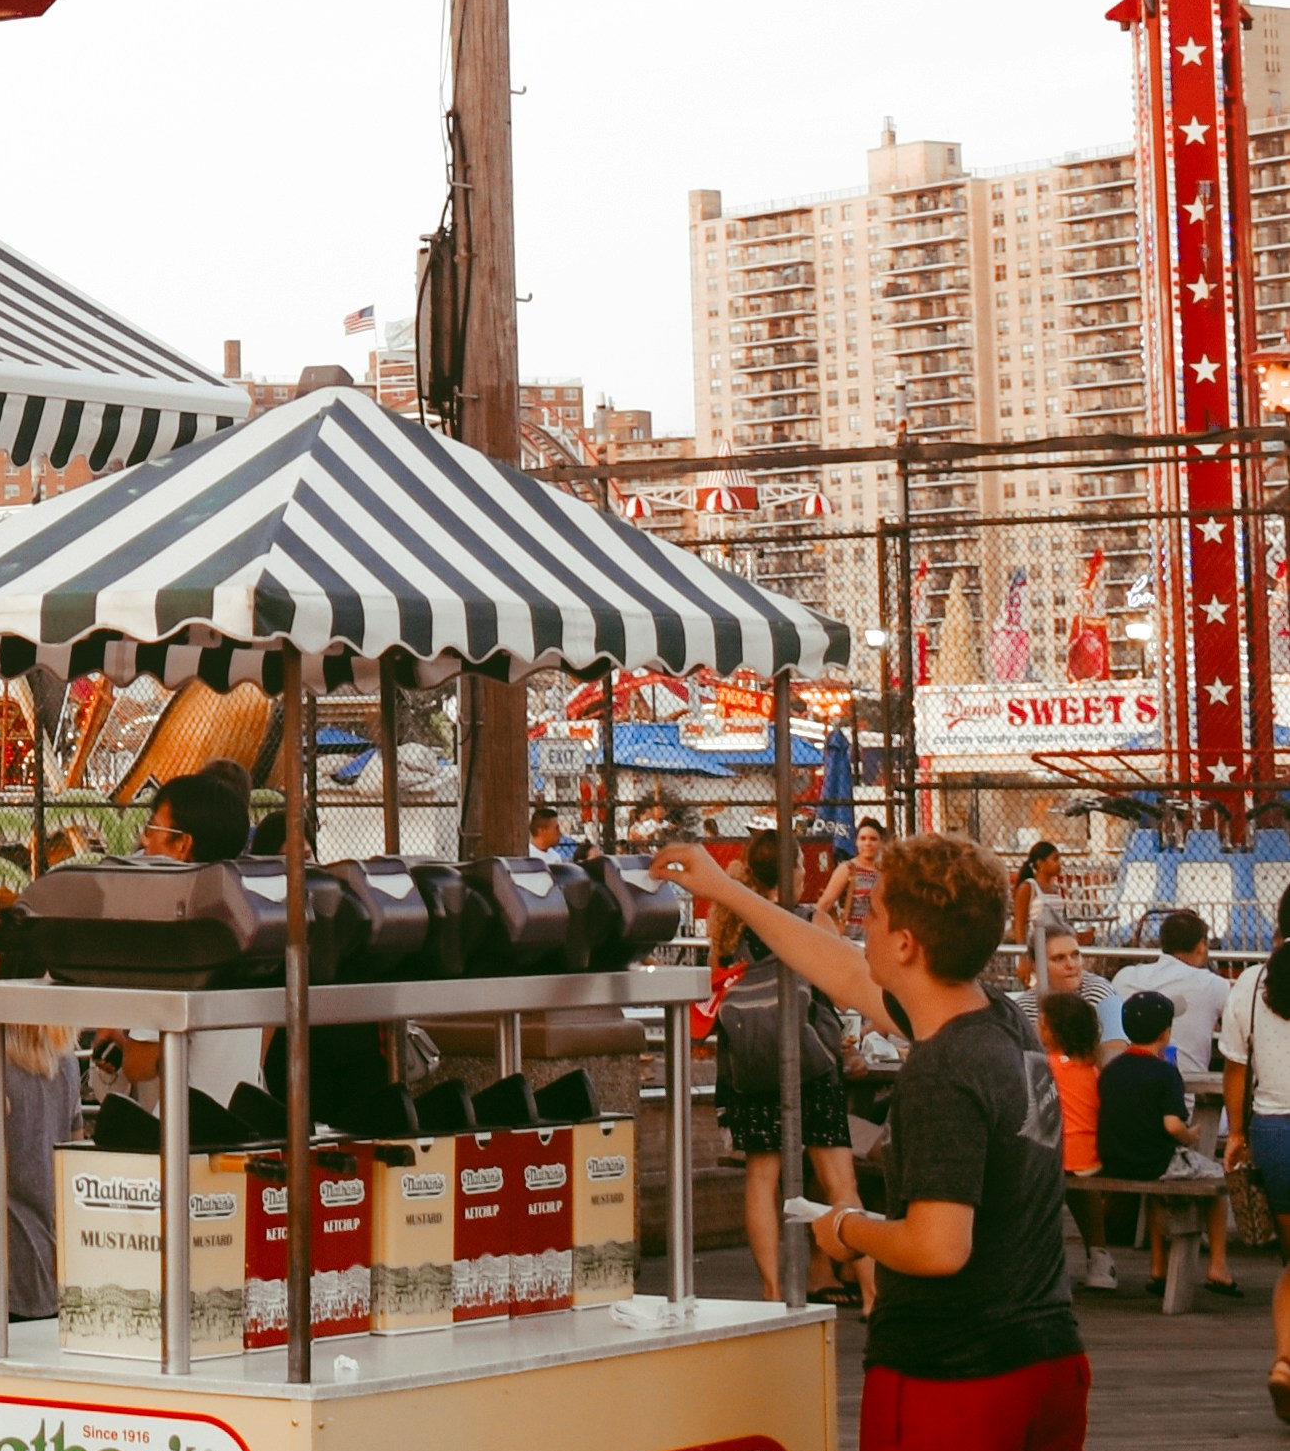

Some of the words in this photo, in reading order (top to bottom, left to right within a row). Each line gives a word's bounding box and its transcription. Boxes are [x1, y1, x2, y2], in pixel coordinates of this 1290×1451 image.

[976, 735, 1011, 745] candy
[548, 749, 575, 764] EXIT
[76, 1176, 162, 1202] Nathan's
[190, 1195, 236, 1213] Nathan's
[590, 1192, 625, 1206] MUSTARD
[464, 1203, 500, 1219] KETCHUP
[528, 1200, 563, 1216] KETCHUP
[323, 1217, 361, 1233] KETCHUP
[405, 1213, 443, 1226] MUSTARD
[80, 1229, 162, 1252] MUSTARD
[192, 1233, 233, 1248] MUSTARD
[82, 1425, 118, 1441] Since
[122, 1428, 150, 1443] 1916
